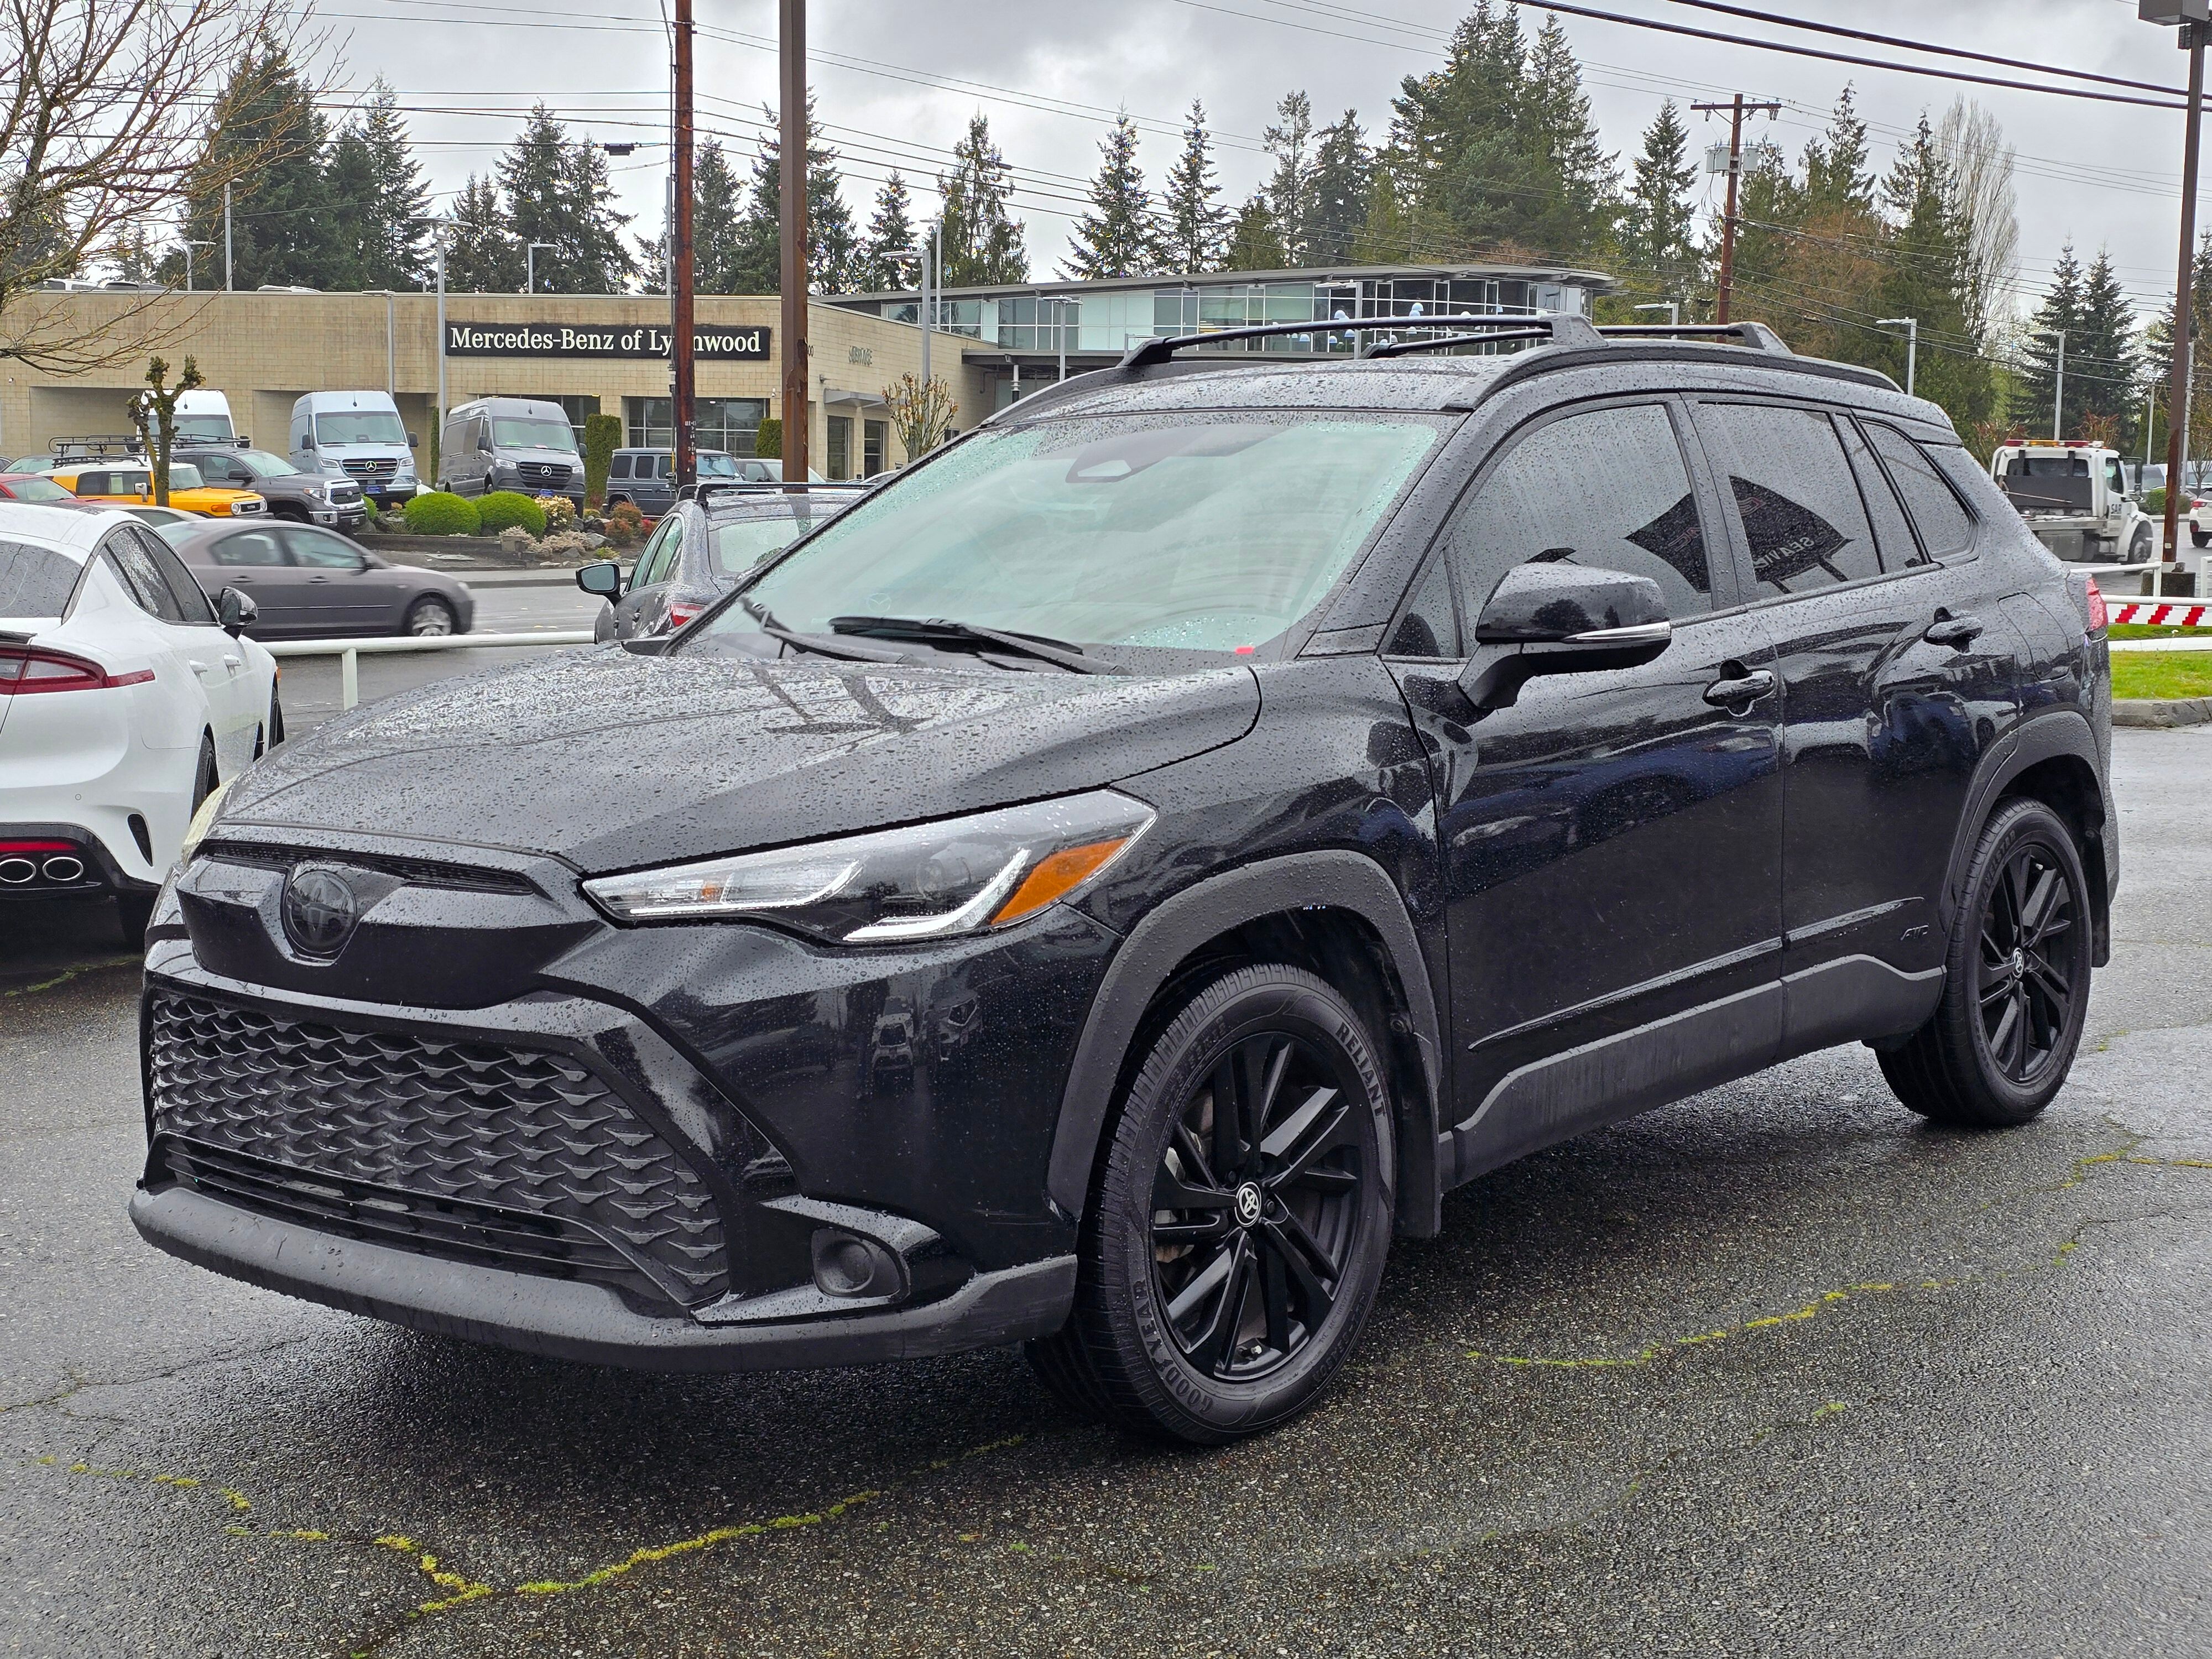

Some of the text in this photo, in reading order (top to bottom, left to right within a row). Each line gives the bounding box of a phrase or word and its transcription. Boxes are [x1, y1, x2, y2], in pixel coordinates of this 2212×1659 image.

[450, 327, 761, 356] Mercedes-Benz of Lynwood
[1335, 1022, 1386, 1117] RELIANT
[1133, 1279, 1213, 1414] GOODYEAR
